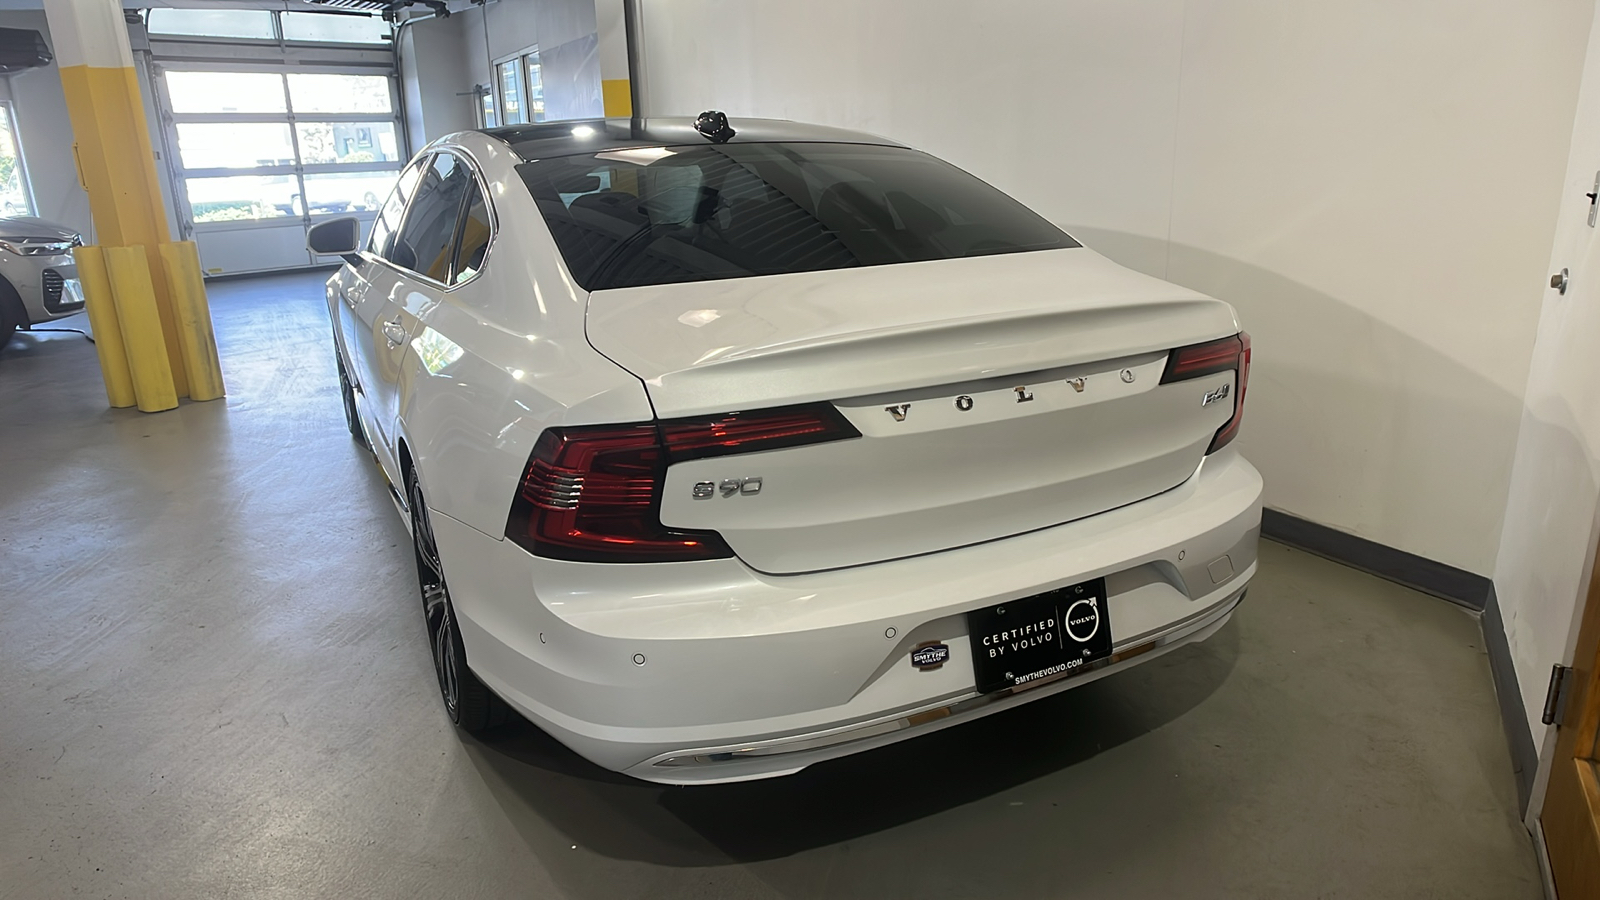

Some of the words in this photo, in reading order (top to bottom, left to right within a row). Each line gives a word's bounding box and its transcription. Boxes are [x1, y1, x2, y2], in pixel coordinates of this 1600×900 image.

[885, 367, 1136, 422] VOLVO
[692, 476, 763, 501] S90
[983, 618, 1054, 646] CERTIFIED
[1070, 614, 1096, 626] VOLVO
[914, 651, 946, 662] SMYTHE
[989, 646, 1005, 658] BY
[1011, 632, 1053, 652] VOLVO
[1015, 658, 1083, 685] SMYTHEVOLVO.COM
